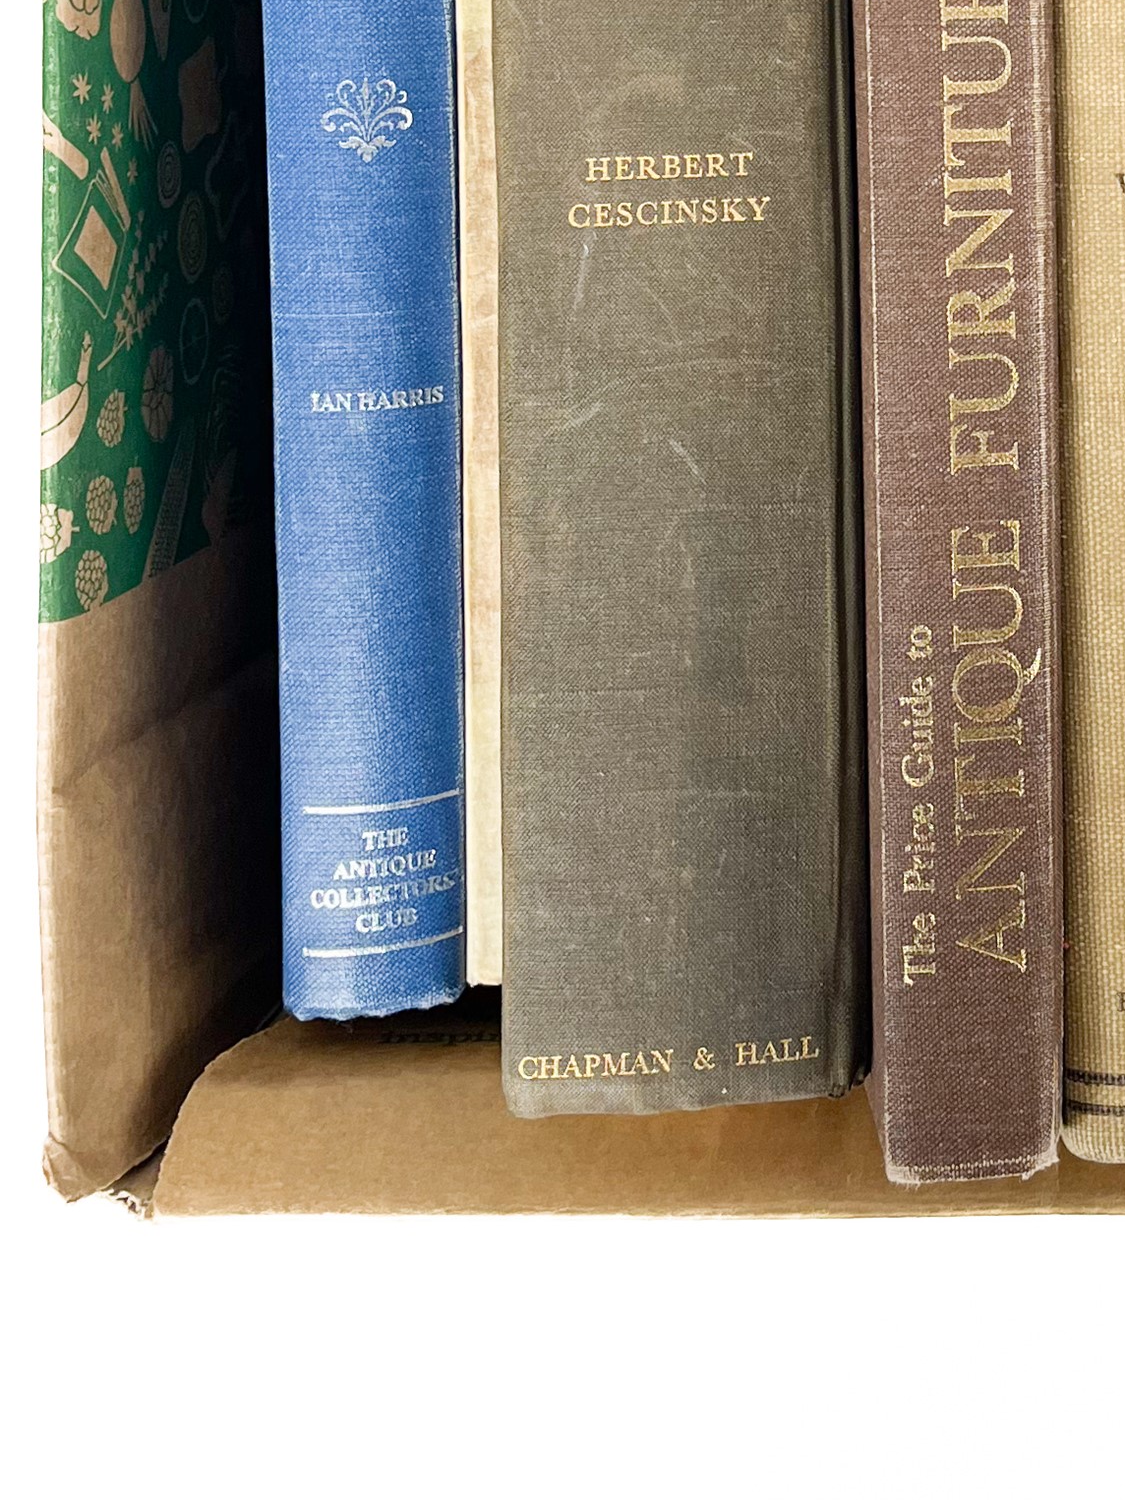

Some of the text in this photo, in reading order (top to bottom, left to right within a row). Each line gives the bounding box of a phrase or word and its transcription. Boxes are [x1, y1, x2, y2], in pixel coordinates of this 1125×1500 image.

[585, 152, 754, 182] HERBERT
[567, 196, 771, 229] CESCINSKY
[310, 385, 444, 413] IAN HARRIS
[951, 519, 1043, 973] ANTIQUE
[898, 624, 938, 987] The Price Guide to
[362, 827, 408, 850] THE
[333, 849, 437, 880] ANTIQUE
[356, 908, 417, 933] CLUB
[518, 1036, 819, 1081] CHAPMAN & HALL
